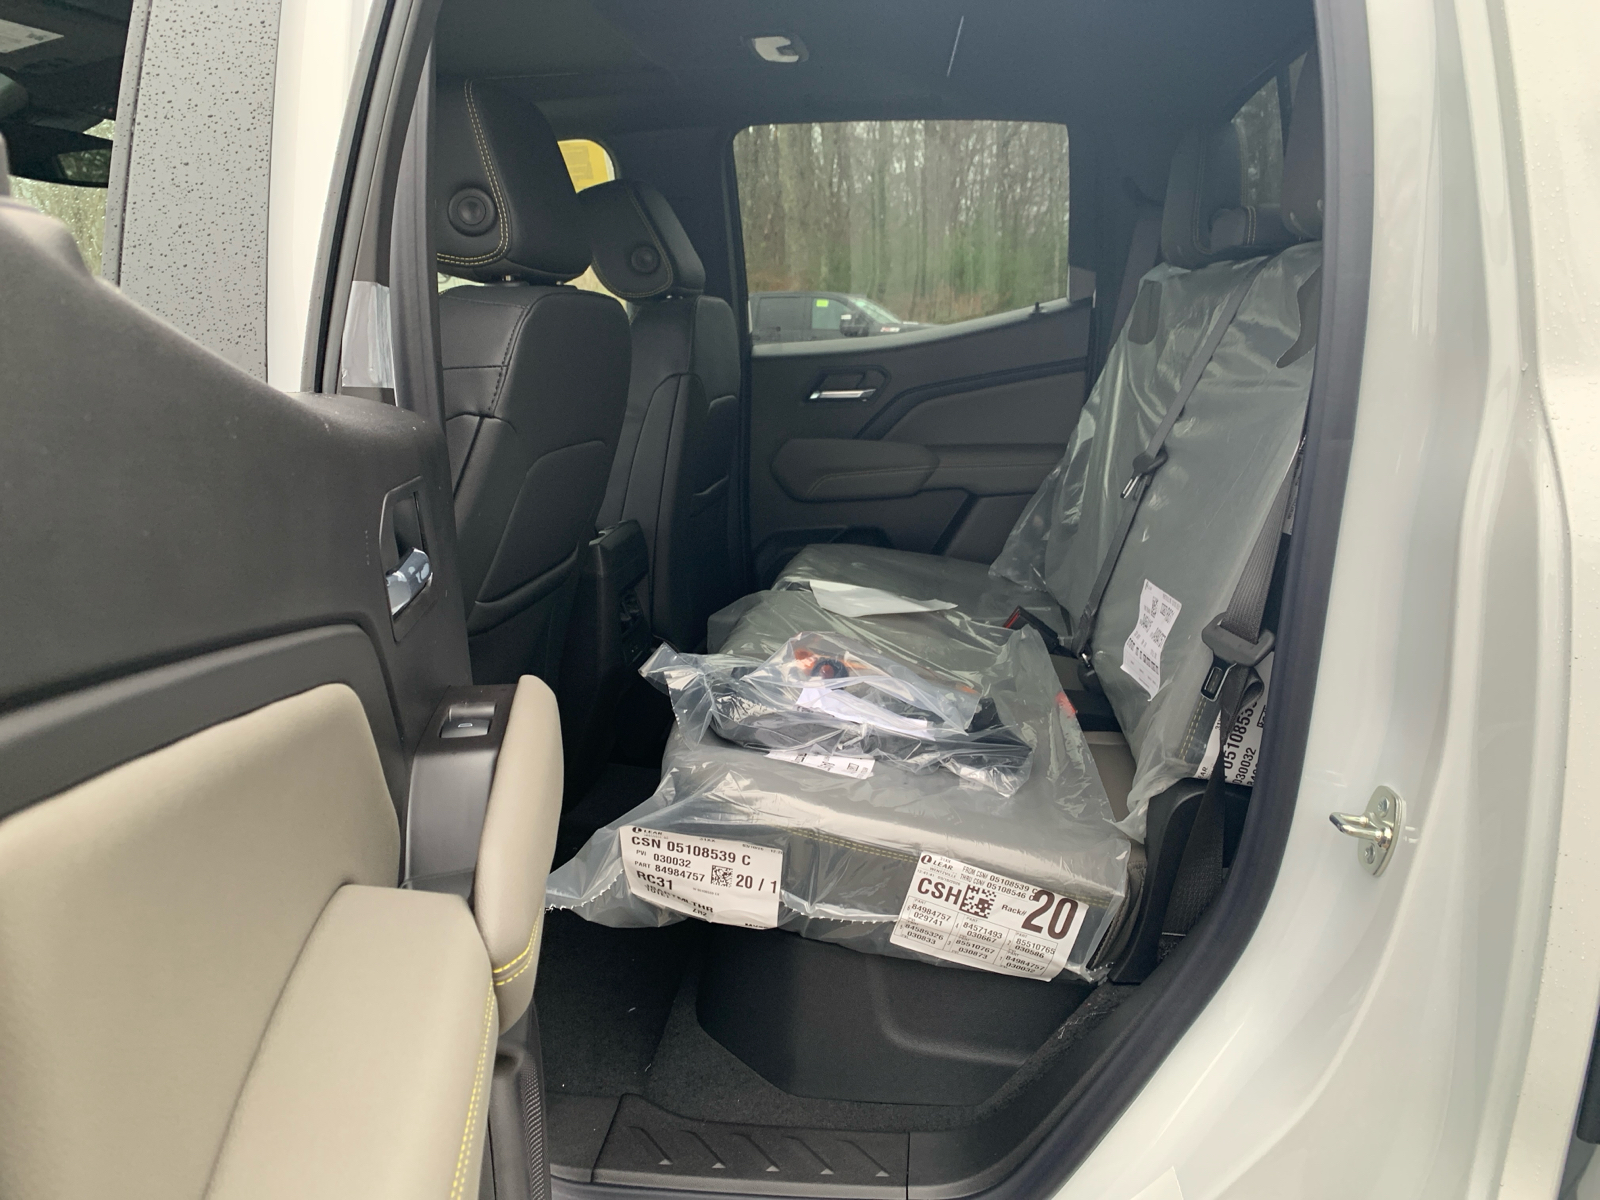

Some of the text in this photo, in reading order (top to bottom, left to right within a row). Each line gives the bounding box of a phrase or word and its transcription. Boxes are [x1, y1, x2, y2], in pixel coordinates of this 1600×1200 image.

[631, 836, 661, 849] CSN
[667, 841, 736, 863] 05108539
[742, 854, 751, 866] C
[653, 853, 692, 868] 030032
[933, 860, 953, 871] LEAR
[634, 860, 705, 882] PART 84984757
[962, 866, 976, 875] FROM
[989, 874, 1030, 892] 05108539
[636, 870, 673, 890] RC31
[735, 874, 777, 894] 20 / 1
[960, 873, 973, 882] THRU
[986, 882, 1026, 899] 05108546
[917, 877, 962, 905] CSH
[911, 903, 951, 921] 84984757
[913, 911, 943, 927] 029741
[1021, 889, 1079, 940] 20
[907, 931, 937, 945] 030833
[963, 921, 1003, 939] 84571493
[966, 930, 997, 943] 030667
[955, 939, 995, 954] 85510767
[958, 947, 988, 960] 030873
[1015, 945, 1045, 959] 030586
[1016, 938, 1056, 955] 85510765
[1005, 955, 1045, 971] 84984757
[1006, 962, 1036, 973] 030032
